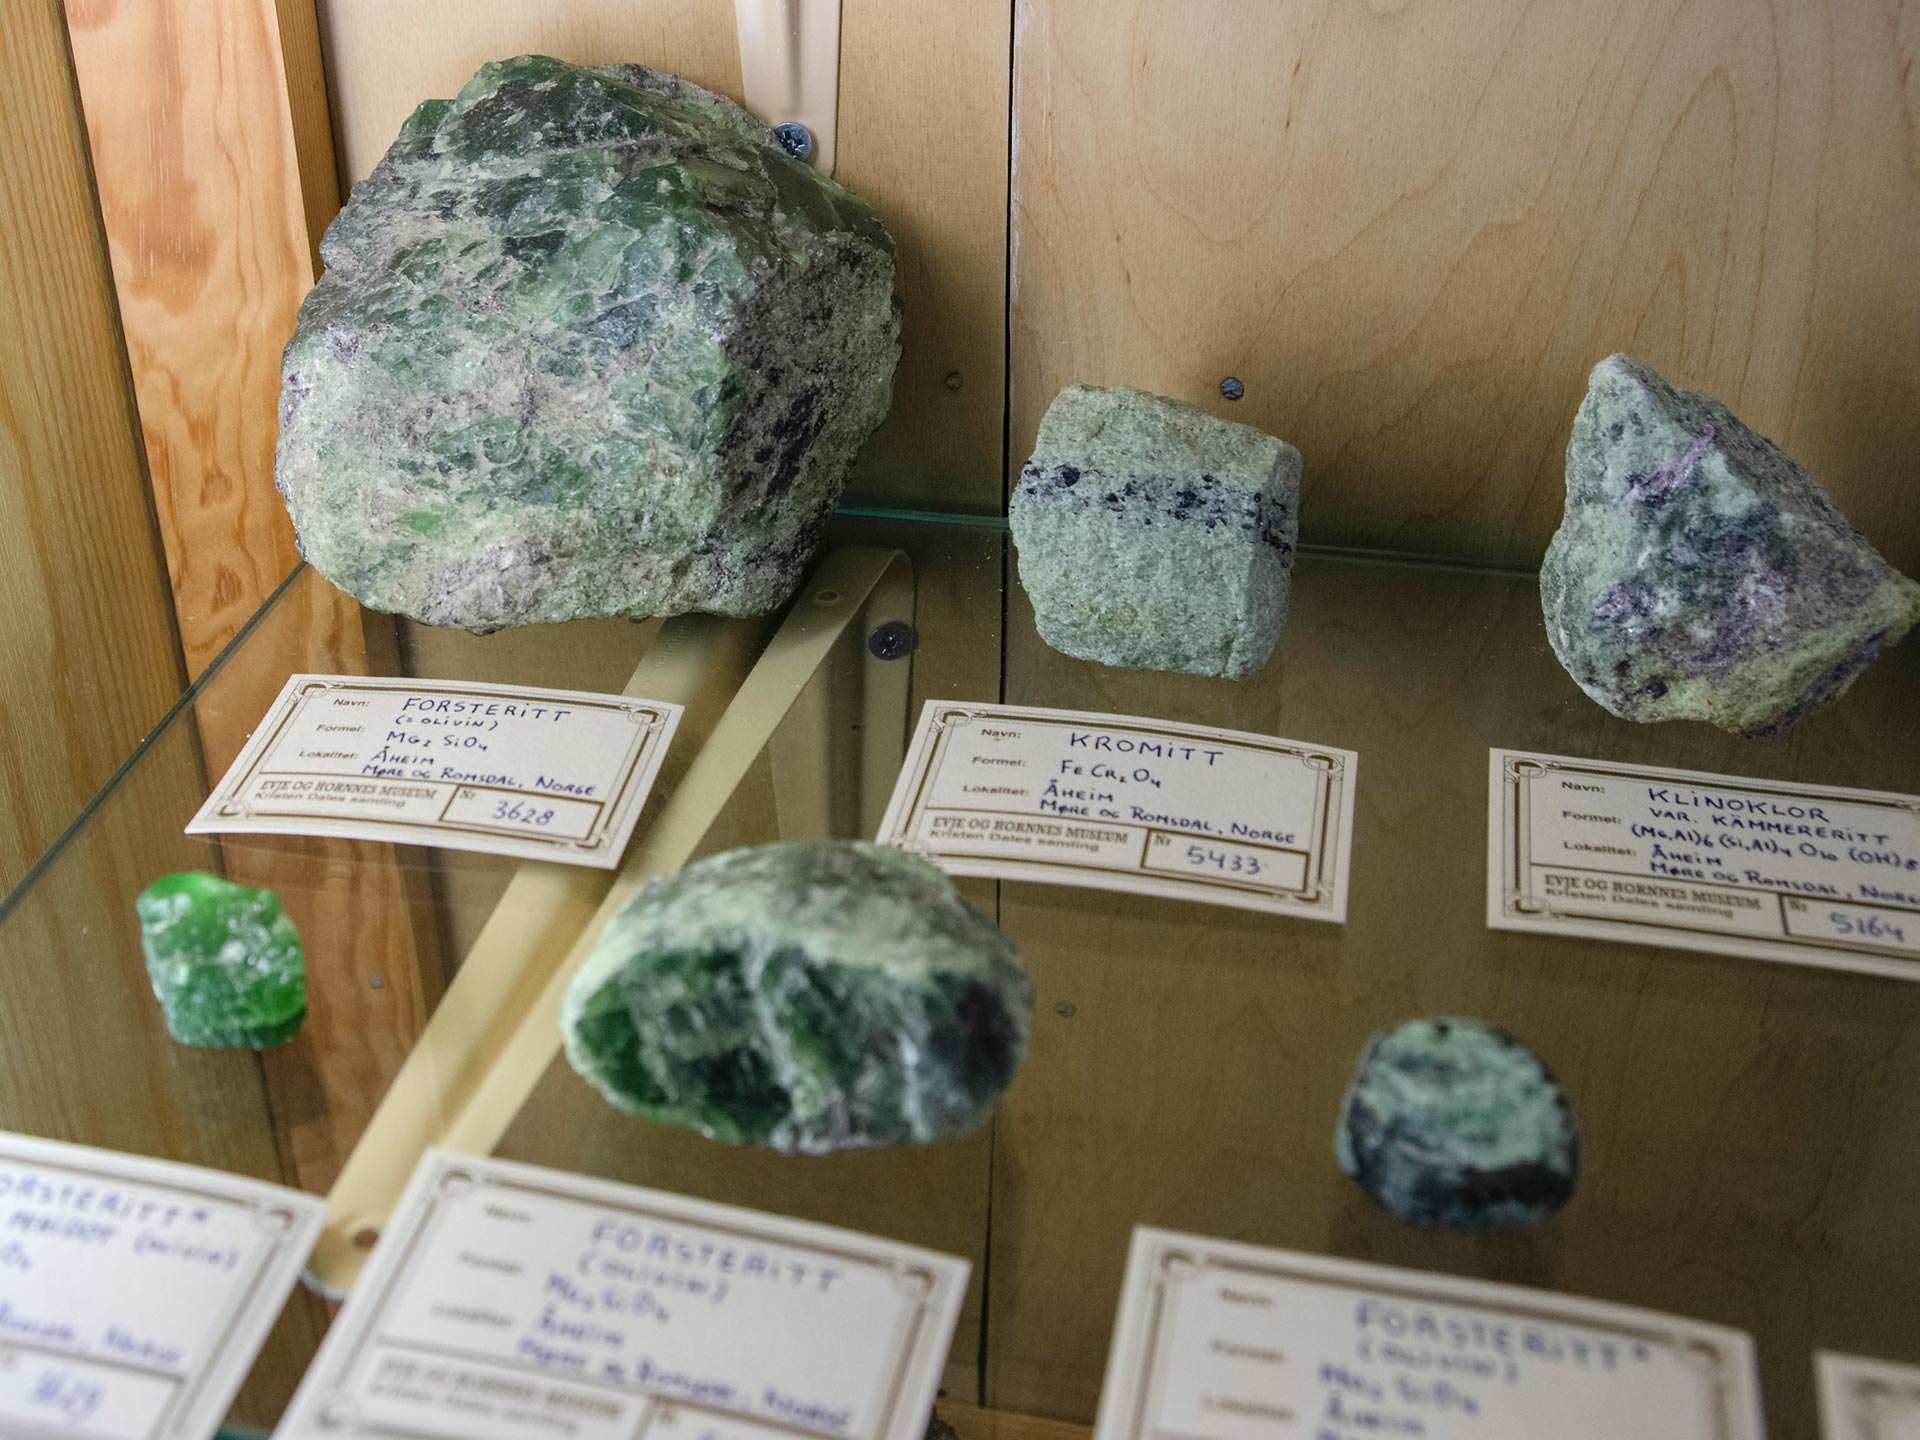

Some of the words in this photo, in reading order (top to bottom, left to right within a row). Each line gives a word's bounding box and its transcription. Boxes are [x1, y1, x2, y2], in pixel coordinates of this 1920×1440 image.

[333, 699, 370, 707] Navn:
[402, 697, 571, 721] FORSTERITT
[316, 724, 365, 733] Formel:
[981, 728, 1022, 738] Navn:
[298, 751, 359, 760] Lokalitet:
[370, 746, 435, 765] ÅHEIM
[1070, 733, 1224, 765] KROMITT
[972, 756, 1026, 767] Formel:
[260, 781, 293, 793] EVJE
[294, 781, 313, 791] OG
[314, 782, 377, 794] HORNNES
[378, 785, 437, 799] MUSEUM
[535, 776, 597, 796] NORGE
[962, 784, 1029, 796] Lokalitet:
[1043, 779, 1114, 802] ÅHEIM
[1562, 781, 1605, 793] Navn:
[255, 792, 302, 801] Kristen
[308, 793, 345, 802] Dales
[350, 797, 406, 808] samling
[1648, 788, 1830, 823] KLINOKLOR
[492, 801, 555, 826] 3628
[1562, 810, 1622, 824] Formel:
[933, 817, 966, 830] EVJE
[969, 818, 990, 829] OG
[993, 819, 1062, 836] HORNNES
[1066, 826, 1129, 843] MUSEUM
[1099, 808, 1120, 820] OG
[1231, 822, 1296, 845] NORGE
[1712, 814, 1890, 845] KÄMMERERITT
[930, 829, 984, 840] Kristen
[989, 832, 1034, 843] Dales
[1037, 837, 1100, 852] samling
[1153, 832, 1172, 846] Nr
[1563, 841, 1637, 857] Lokalitet:
[1186, 846, 1262, 875] 5433
[1651, 844, 1723, 866] ÅHEIM
[1545, 874, 1581, 892] EVJE
[1584, 878, 1608, 891] OG
[1613, 879, 1688, 900] HORNNES
[1692, 891, 1761, 910] MUSEUM
[1829, 911, 1904, 941] 5164
[592, 1219, 843, 1294] FORSTERITT
